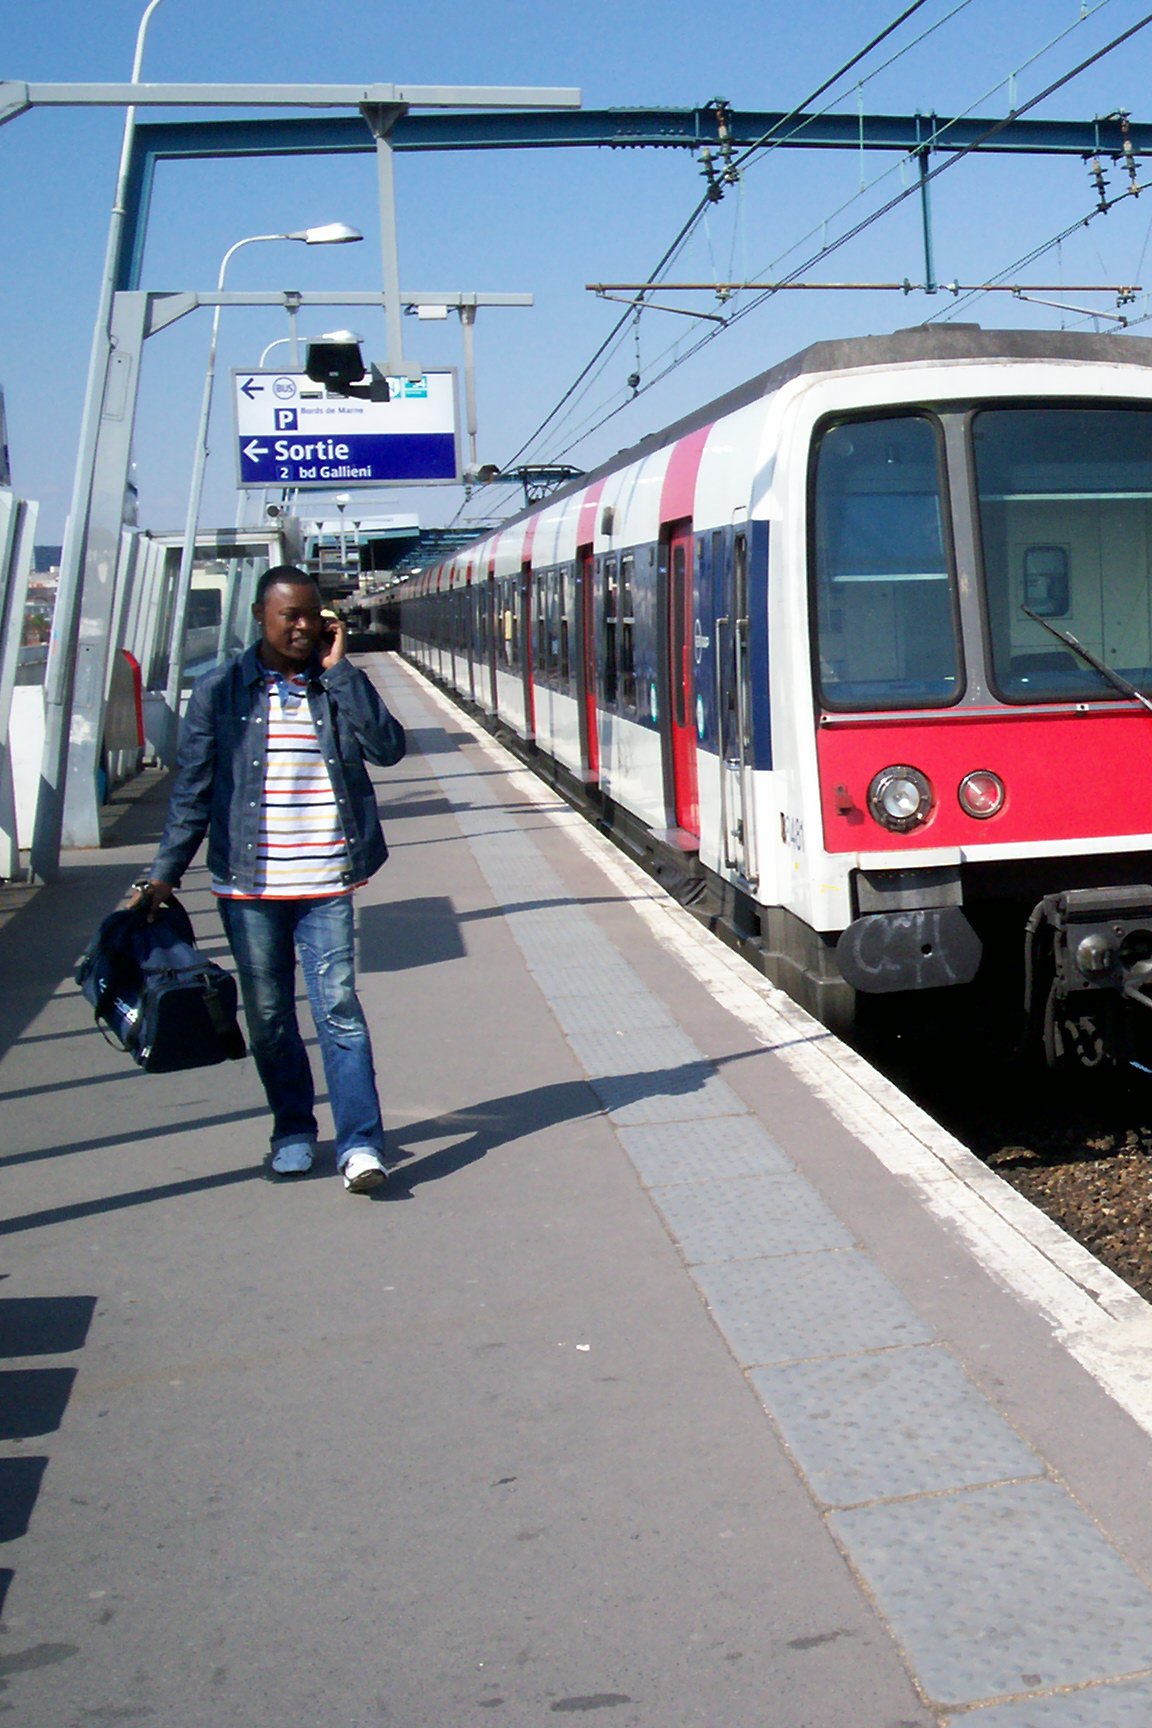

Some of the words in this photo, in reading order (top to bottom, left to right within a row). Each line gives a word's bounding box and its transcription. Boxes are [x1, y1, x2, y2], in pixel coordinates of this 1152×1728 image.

[276, 384, 293, 393] BUS
[279, 410, 294, 429] P
[274, 439, 349, 461] Sortie
[280, 467, 289, 478] 2
[299, 466, 317, 478] bd
